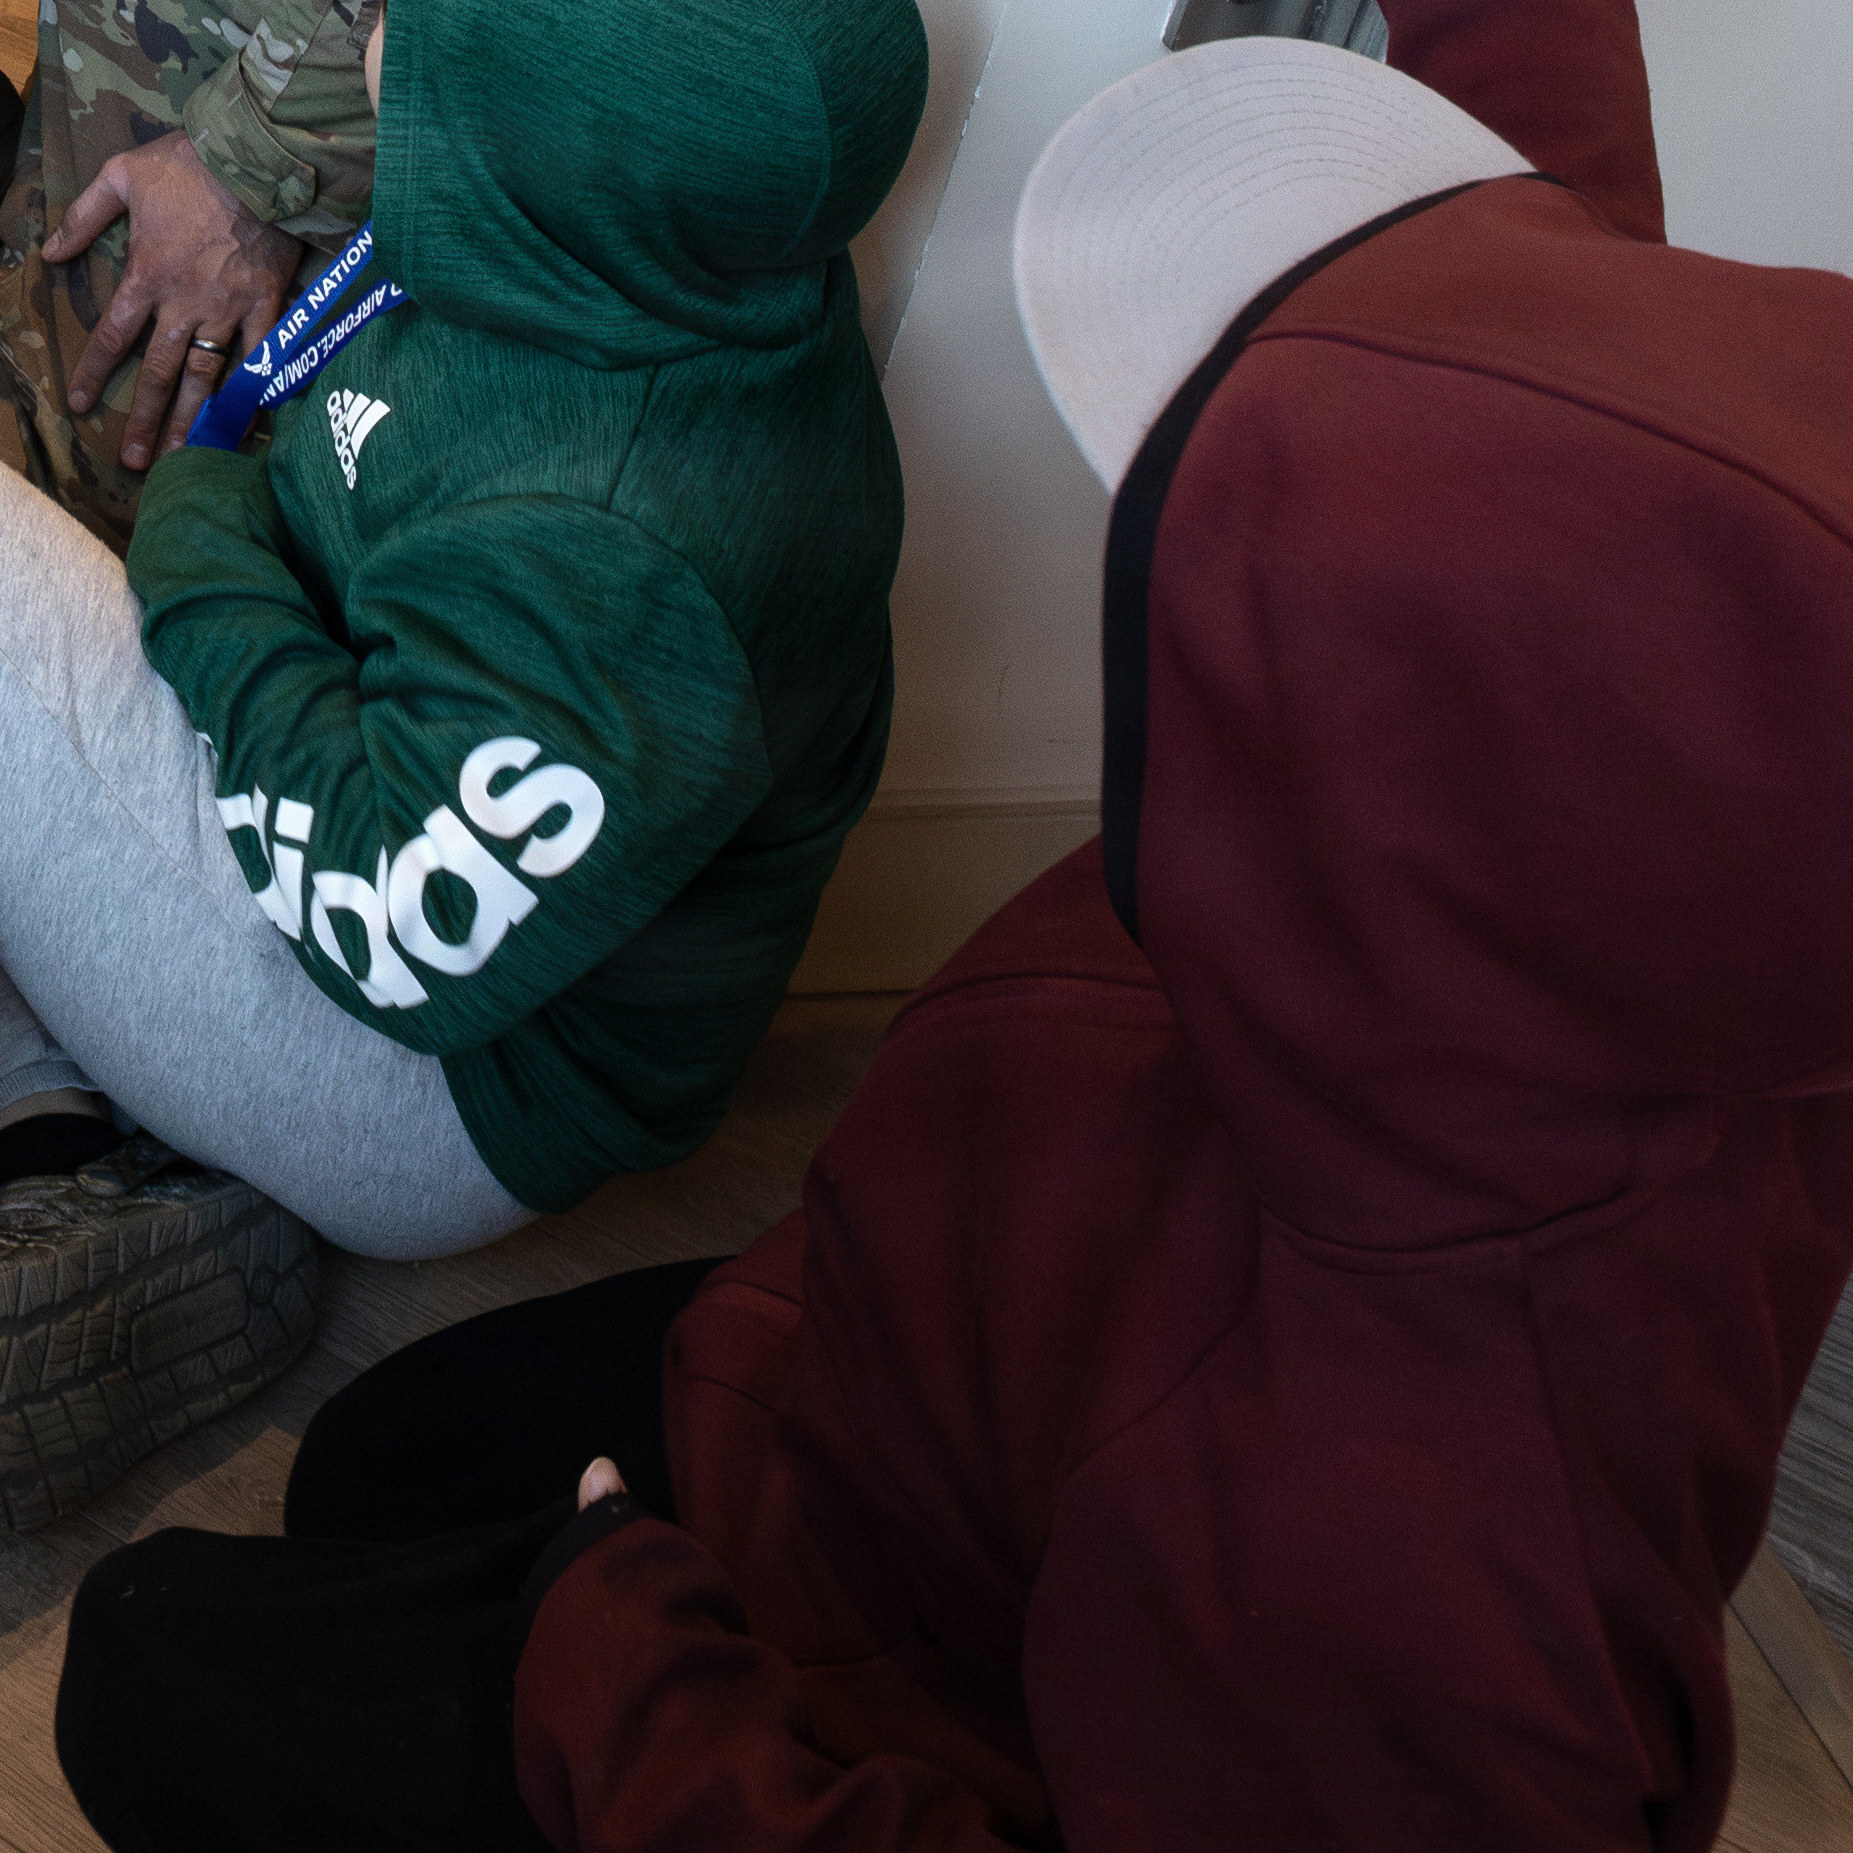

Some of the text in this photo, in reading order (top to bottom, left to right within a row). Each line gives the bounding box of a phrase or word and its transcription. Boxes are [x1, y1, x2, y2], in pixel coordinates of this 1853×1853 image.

[277, 307, 310, 350] AIR
[326, 389, 358, 491] adidas
[215, 735, 606, 1010] didas
